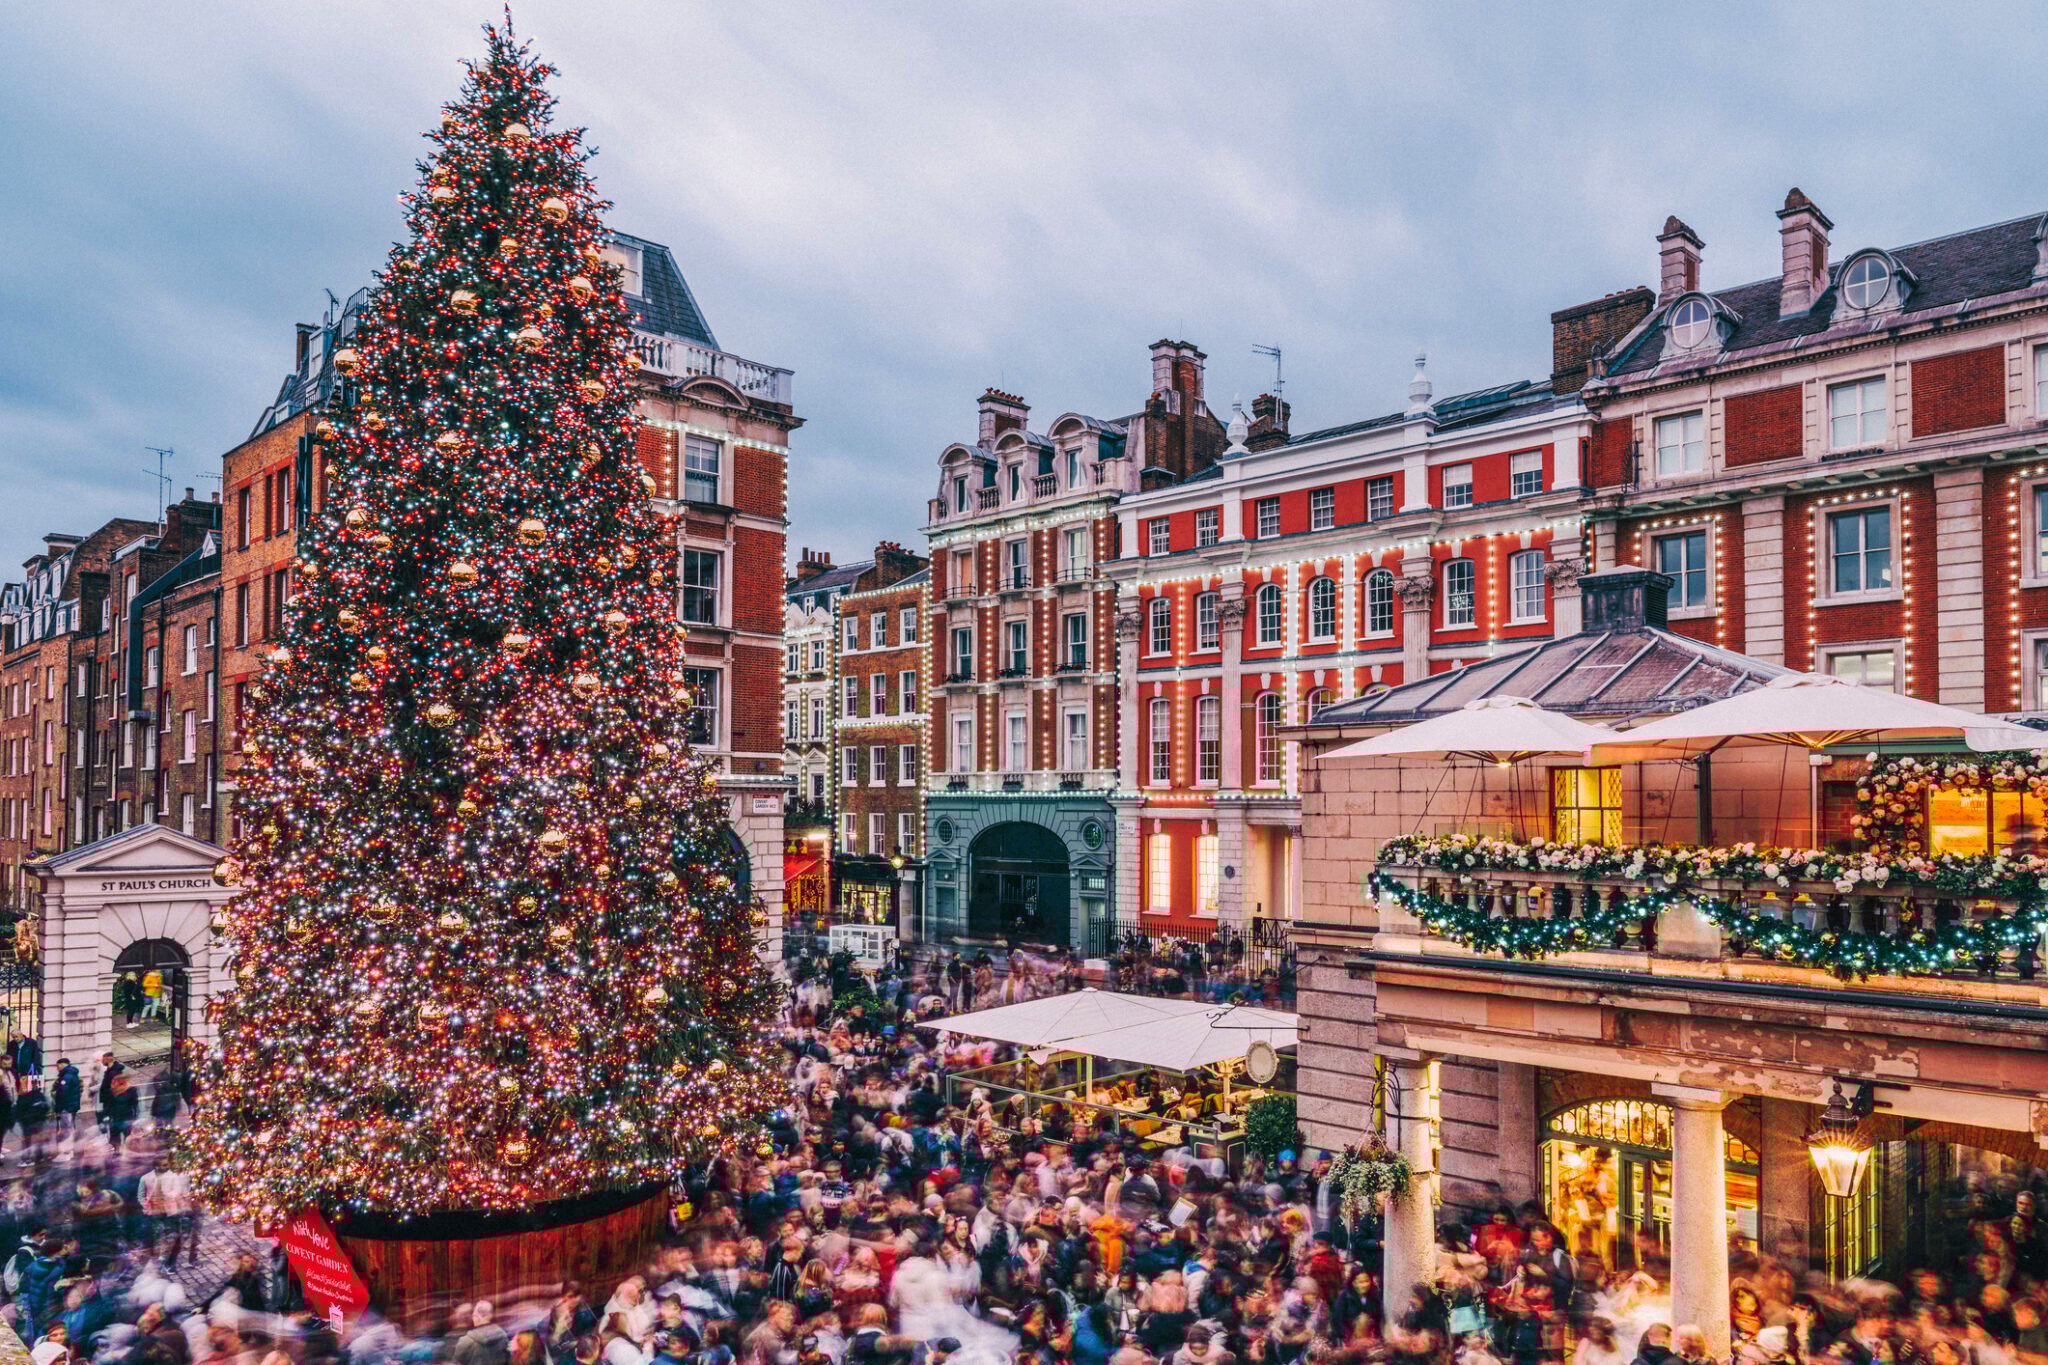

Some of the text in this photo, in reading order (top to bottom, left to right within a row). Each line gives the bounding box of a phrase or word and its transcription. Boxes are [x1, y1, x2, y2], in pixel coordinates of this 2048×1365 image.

[101, 879, 211, 891] ST PAUL'S CHURCH
[286, 1242, 349, 1274] COVENT GARDEN
